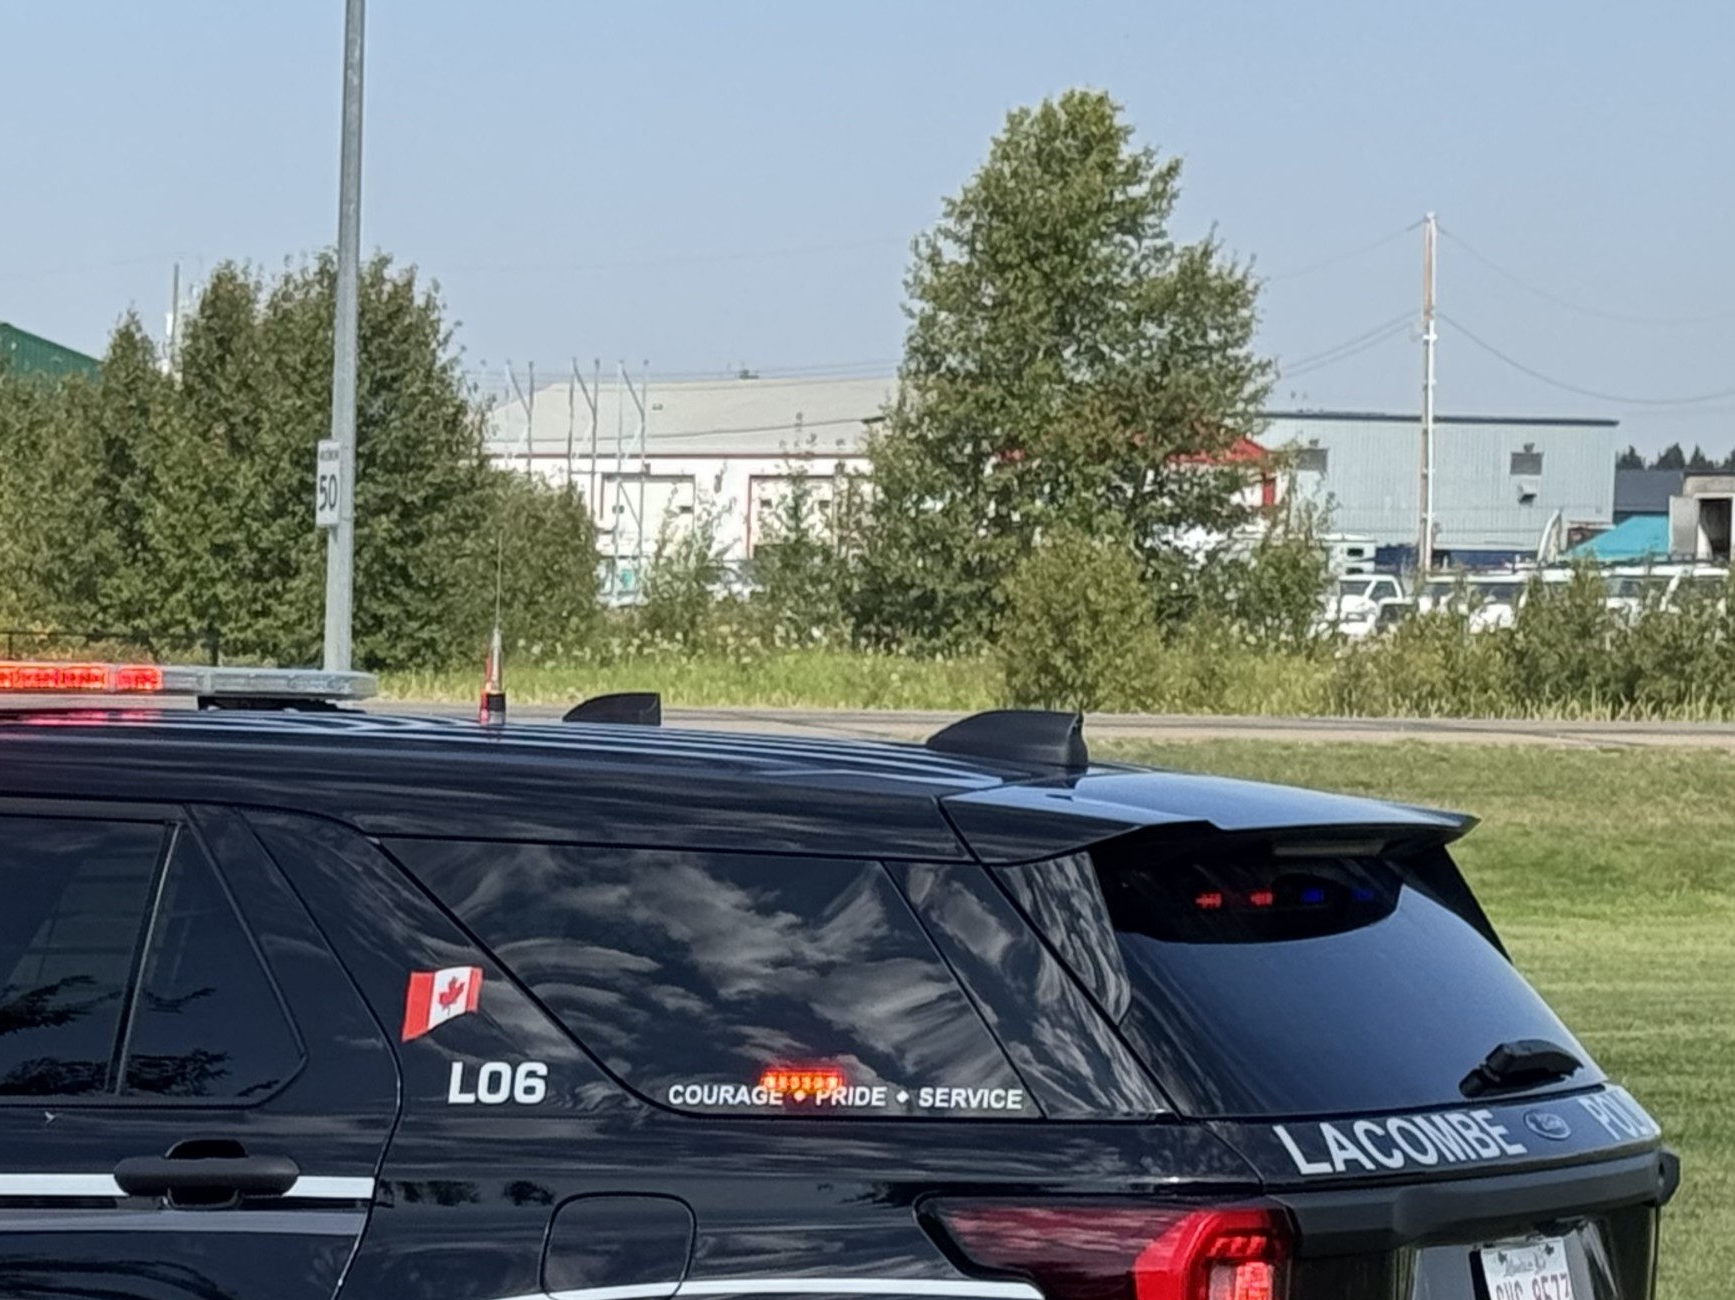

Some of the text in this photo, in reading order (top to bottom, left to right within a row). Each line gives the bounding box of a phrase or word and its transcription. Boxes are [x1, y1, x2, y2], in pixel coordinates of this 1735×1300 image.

[318, 474, 338, 512] 50
[668, 1084, 1023, 1110] COURAGE PRIDE SERVICE
[1272, 1109, 1528, 1175] LACOMBE
